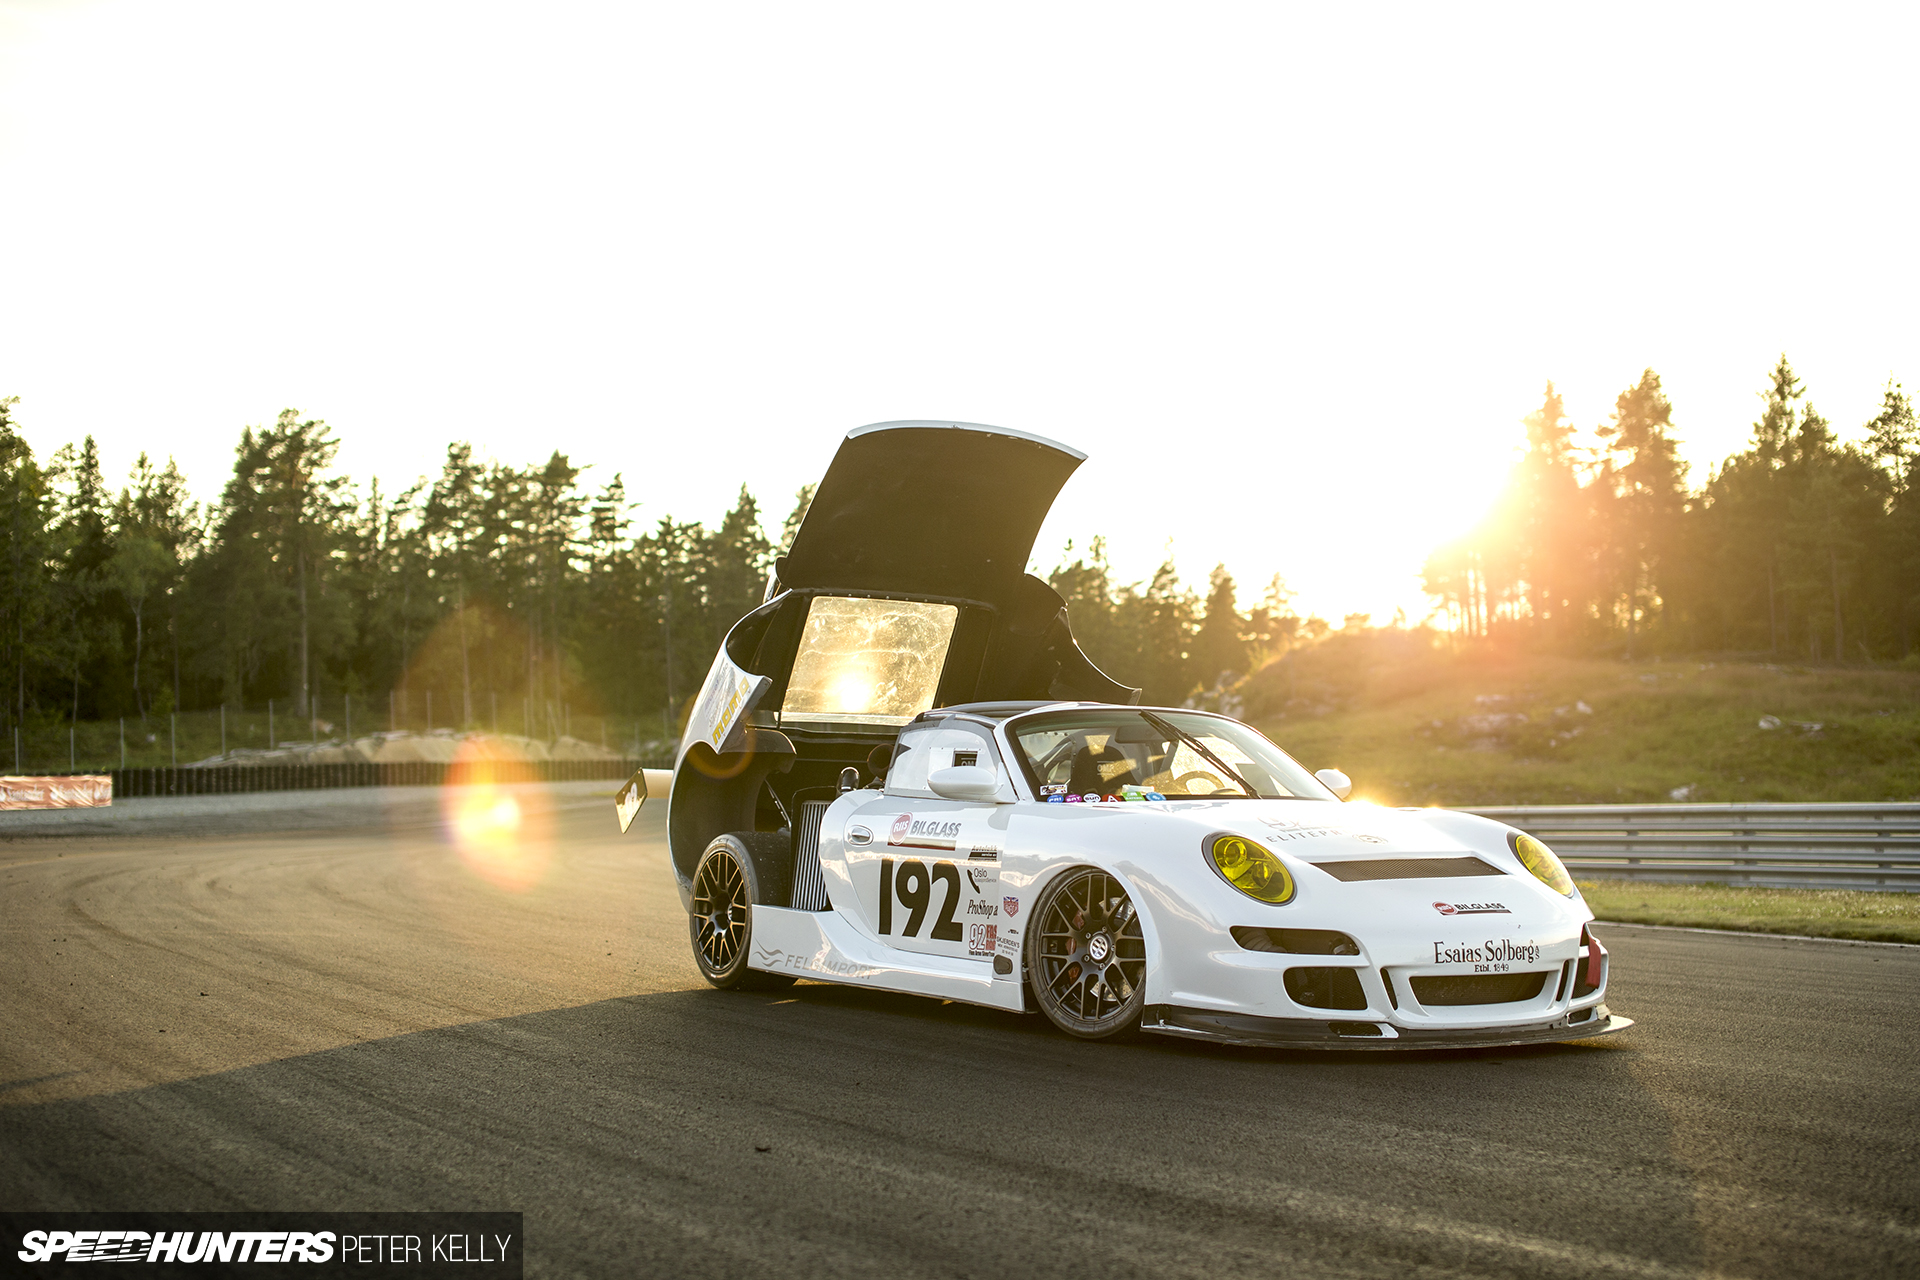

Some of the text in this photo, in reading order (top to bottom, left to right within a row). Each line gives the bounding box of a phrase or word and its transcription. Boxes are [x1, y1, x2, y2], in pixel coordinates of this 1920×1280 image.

[910, 820, 962, 838] BILGLASS
[974, 867, 988, 878] Oslo
[878, 858, 963, 942] 192
[1454, 903, 1506, 911] BILGLASS
[968, 923, 986, 951] 92
[1433, 941, 1482, 964] Esaias
[1484, 938, 1535, 964] Solberg
